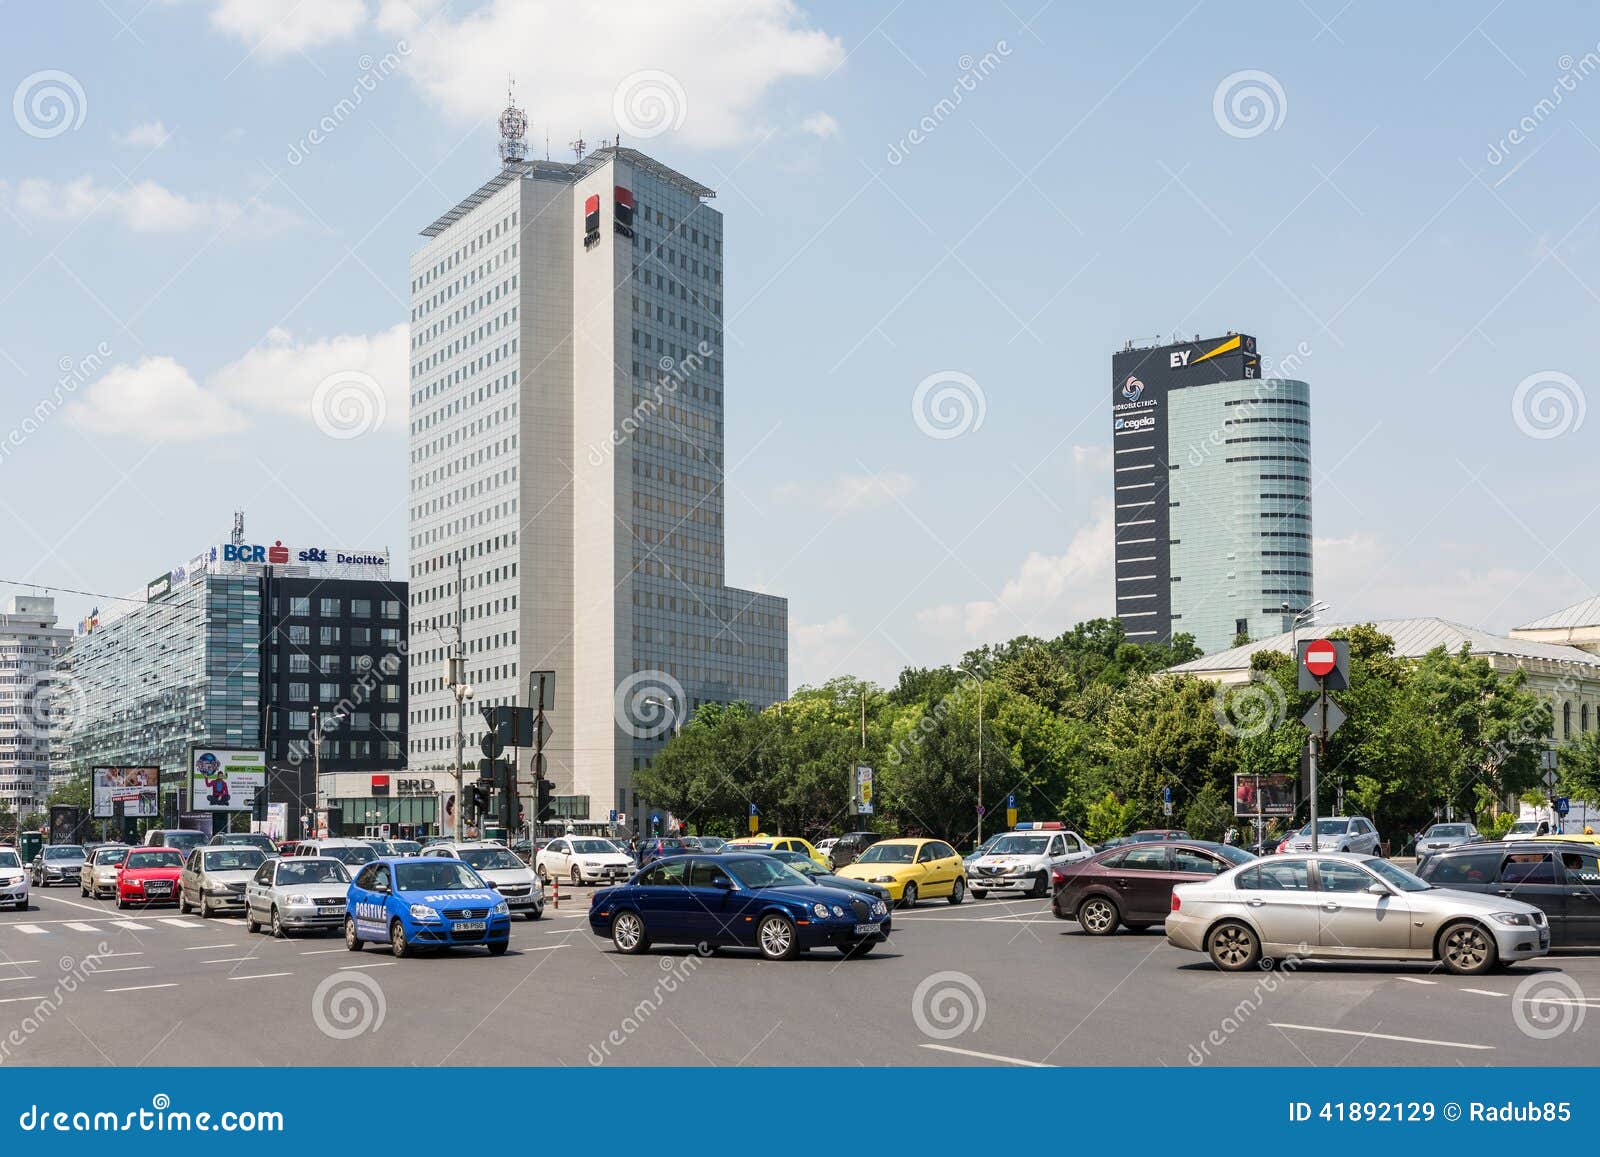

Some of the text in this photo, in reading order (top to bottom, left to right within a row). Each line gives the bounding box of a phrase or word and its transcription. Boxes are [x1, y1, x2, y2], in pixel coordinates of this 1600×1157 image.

[1170, 350, 1191, 368] EY
[1245, 366, 1255, 379] EY
[1124, 417, 1155, 430] cegeka
[224, 544, 266, 562] BCR
[298, 547, 328, 562] s&t
[397, 778, 436, 790] BRD
[355, 902, 388, 920] POSITIVE
